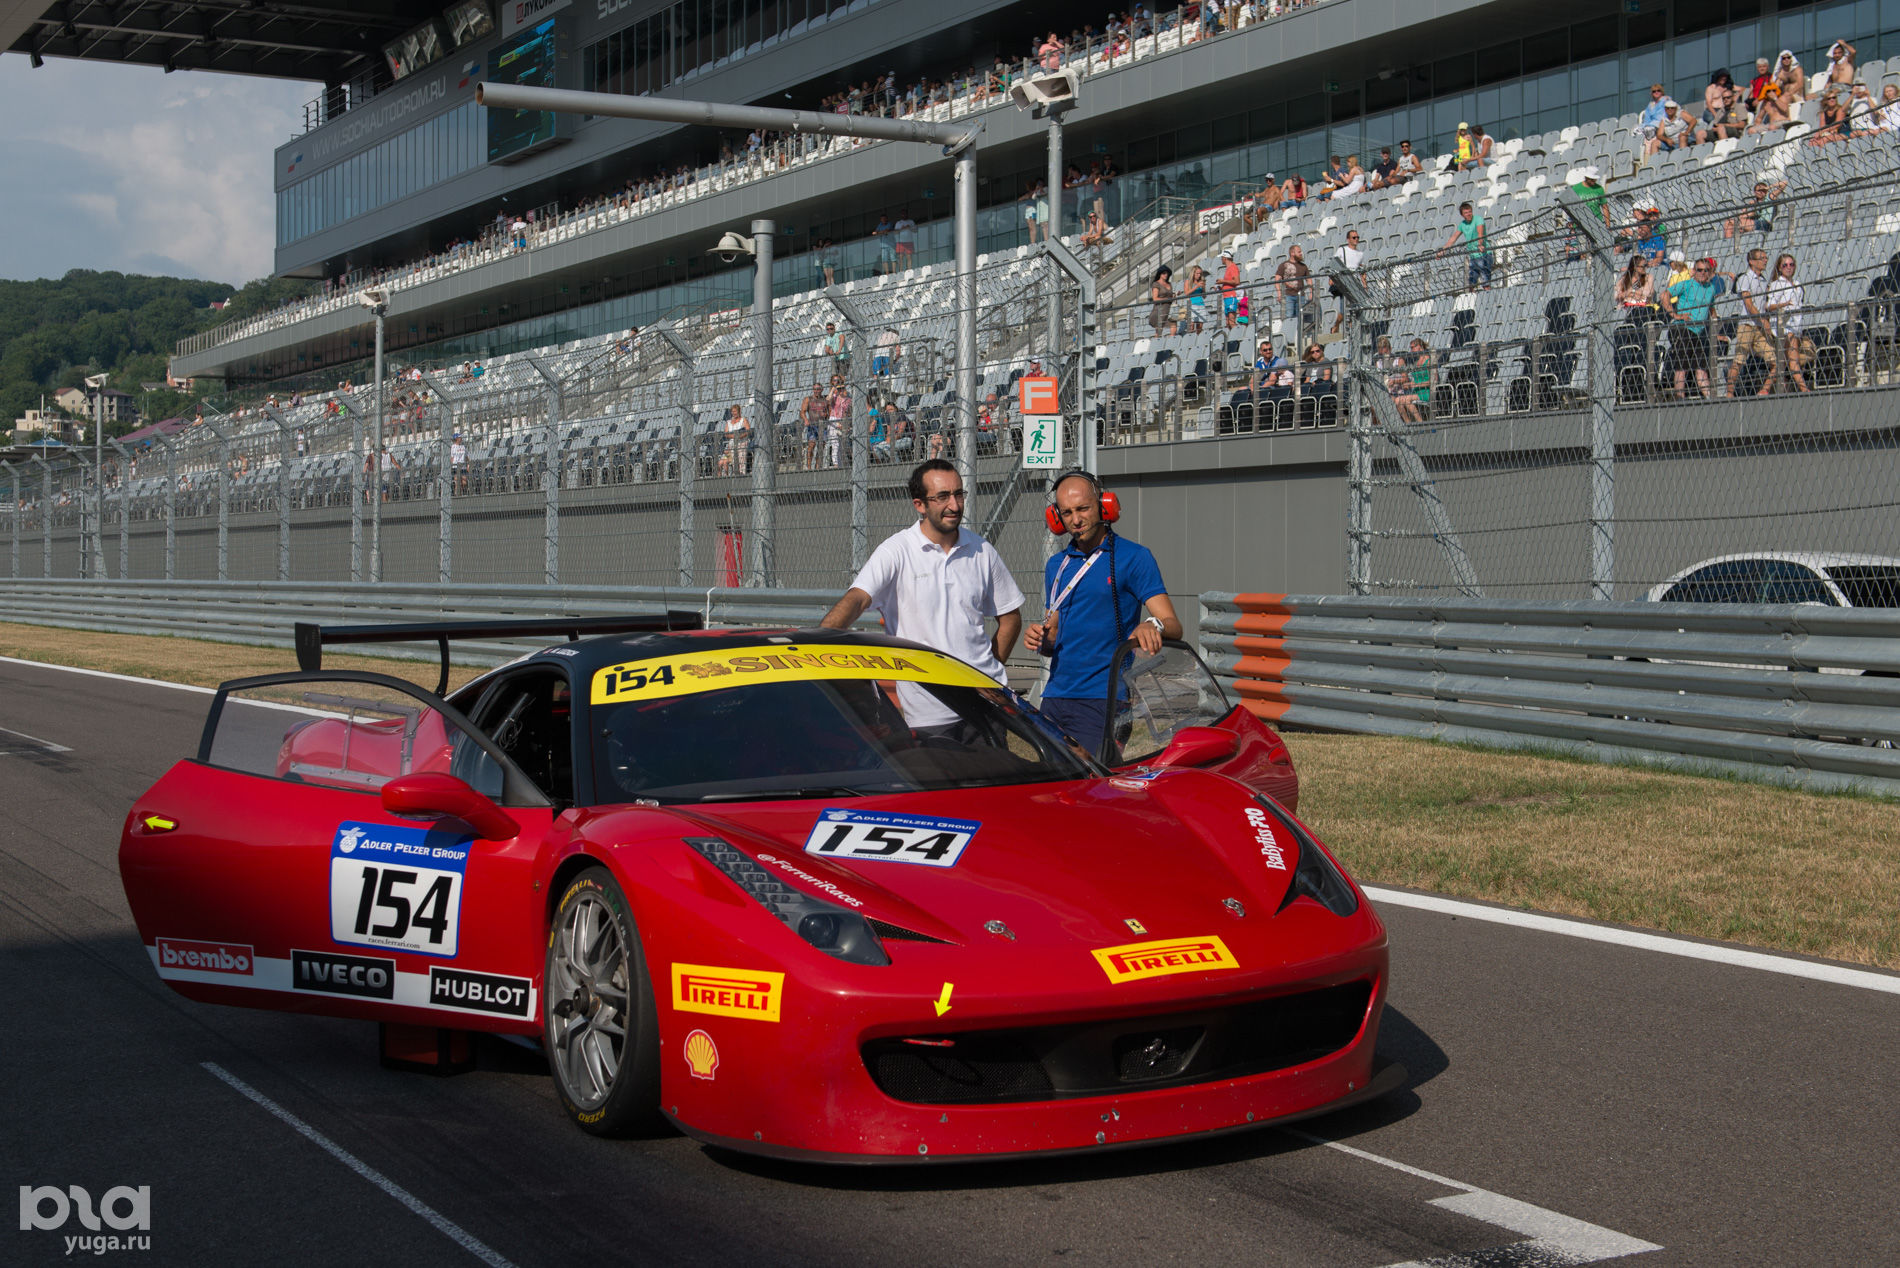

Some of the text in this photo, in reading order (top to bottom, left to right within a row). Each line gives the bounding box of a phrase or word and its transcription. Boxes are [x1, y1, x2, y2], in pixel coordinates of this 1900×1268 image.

[312, 76, 447, 159] WWW.SOCHIAUTODROM.RU
[1024, 381, 1053, 410] F
[1027, 456, 1055, 464] EXIT
[605, 653, 929, 696] 154 SINGHA
[892, 818, 934, 826] PELZER
[937, 822, 976, 830] GROUP
[1244, 807, 1270, 829] PRO
[360, 839, 466, 860] ADLER PELZER GROUP
[818, 824, 958, 861] 154
[757, 853, 864, 908] @FerrariRaces
[354, 866, 453, 944] 154
[162, 943, 249, 971] brembo
[368, 938, 420, 949] races.ferrari.com
[1108, 943, 1223, 974] PIRELLI
[302, 960, 388, 989] IVECO
[434, 977, 525, 1007] HUBLOT
[680, 974, 771, 1011] PIRELLI
